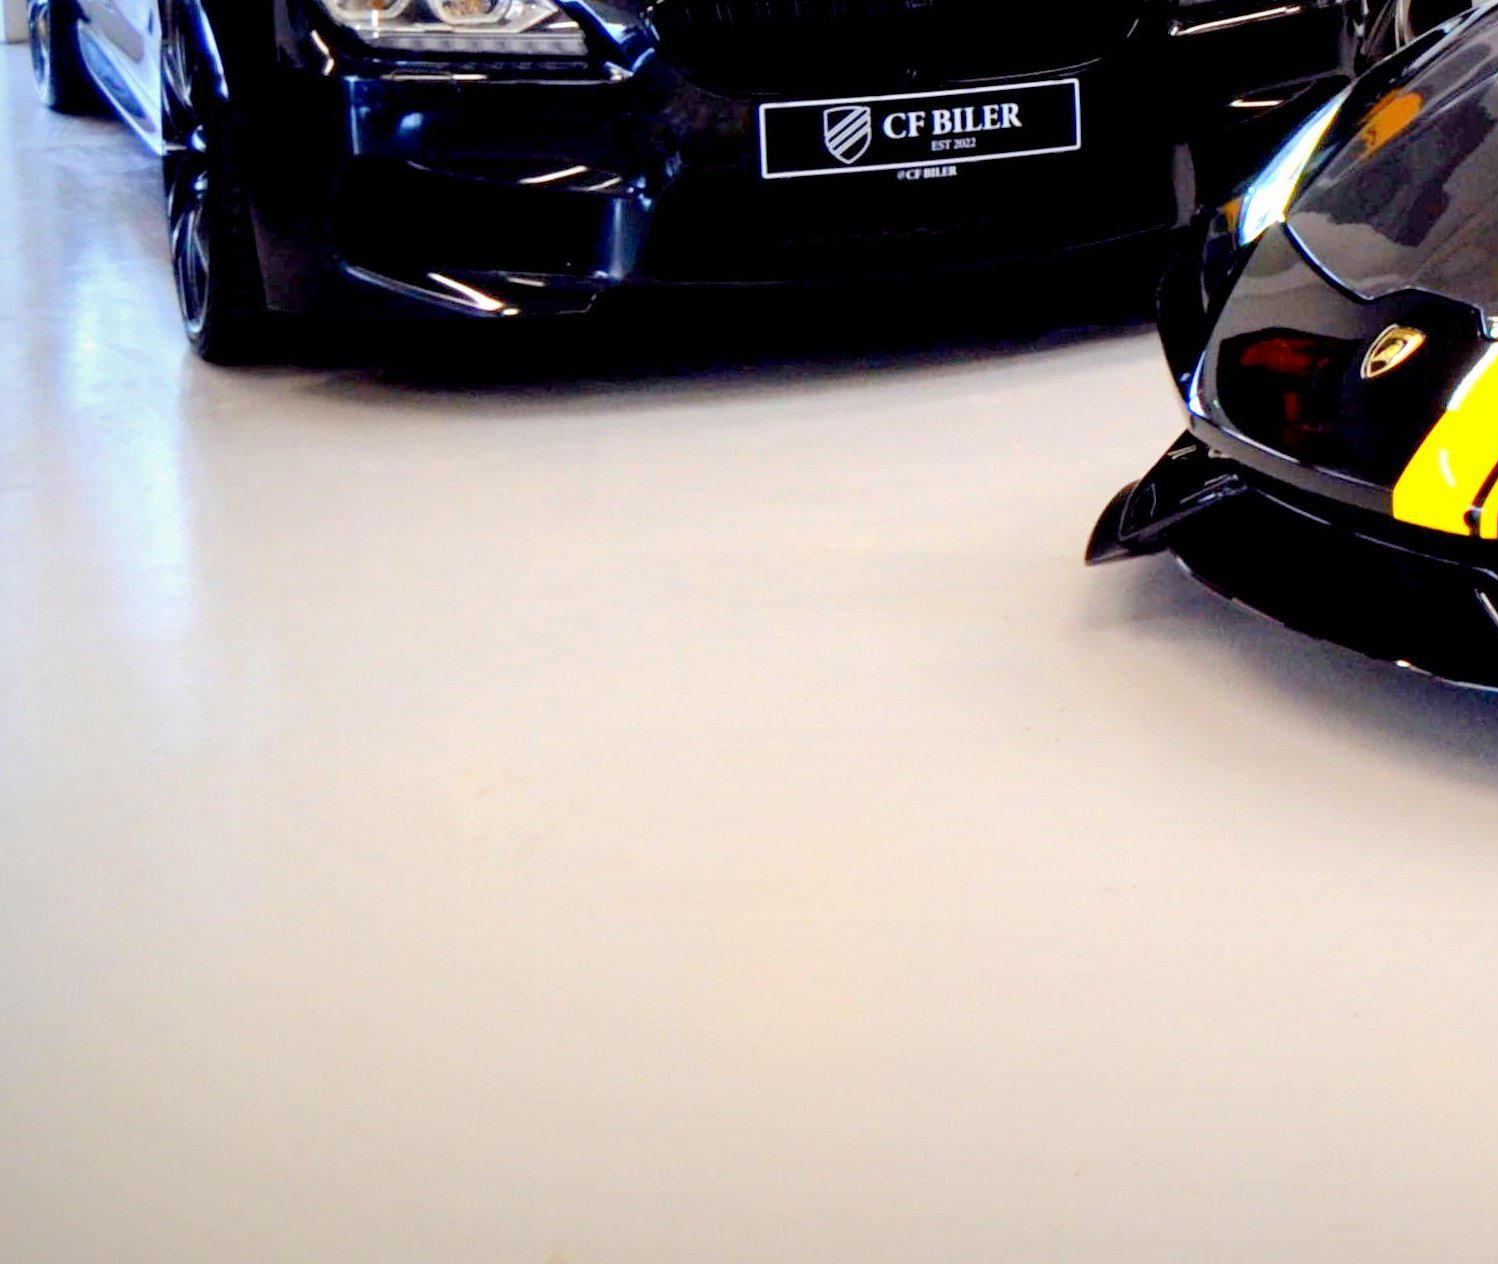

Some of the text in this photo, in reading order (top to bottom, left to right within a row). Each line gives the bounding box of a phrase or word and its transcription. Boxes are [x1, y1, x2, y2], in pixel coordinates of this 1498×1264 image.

[883, 102, 1022, 139] CF BILER
[931, 137, 976, 152] EST 2022
